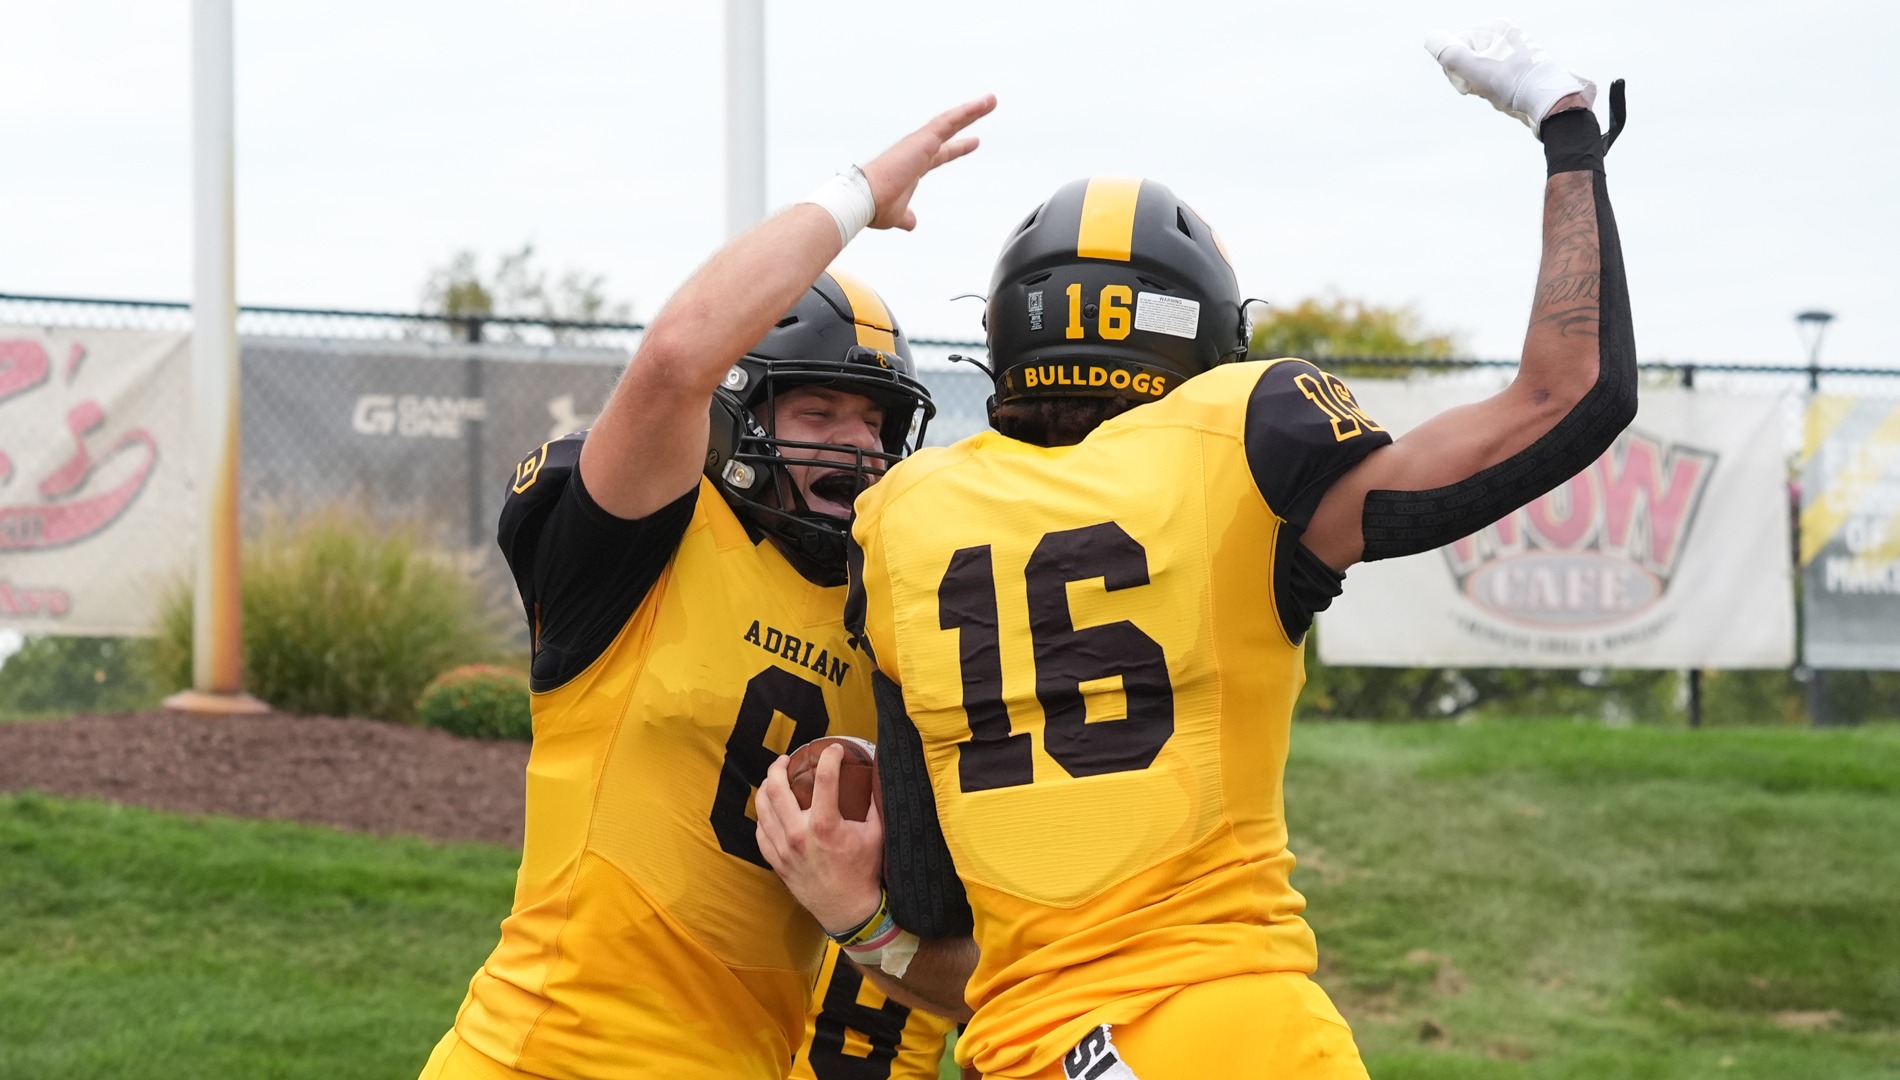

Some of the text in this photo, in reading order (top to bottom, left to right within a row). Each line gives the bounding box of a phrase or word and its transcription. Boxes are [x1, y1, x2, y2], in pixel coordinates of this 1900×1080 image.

[1066, 283, 1132, 340] 16
[1024, 365, 1166, 396] BULLDOGS
[744, 619, 850, 687] ADRIAN
[938, 521, 1174, 793] 16
[710, 664, 830, 871] 8
